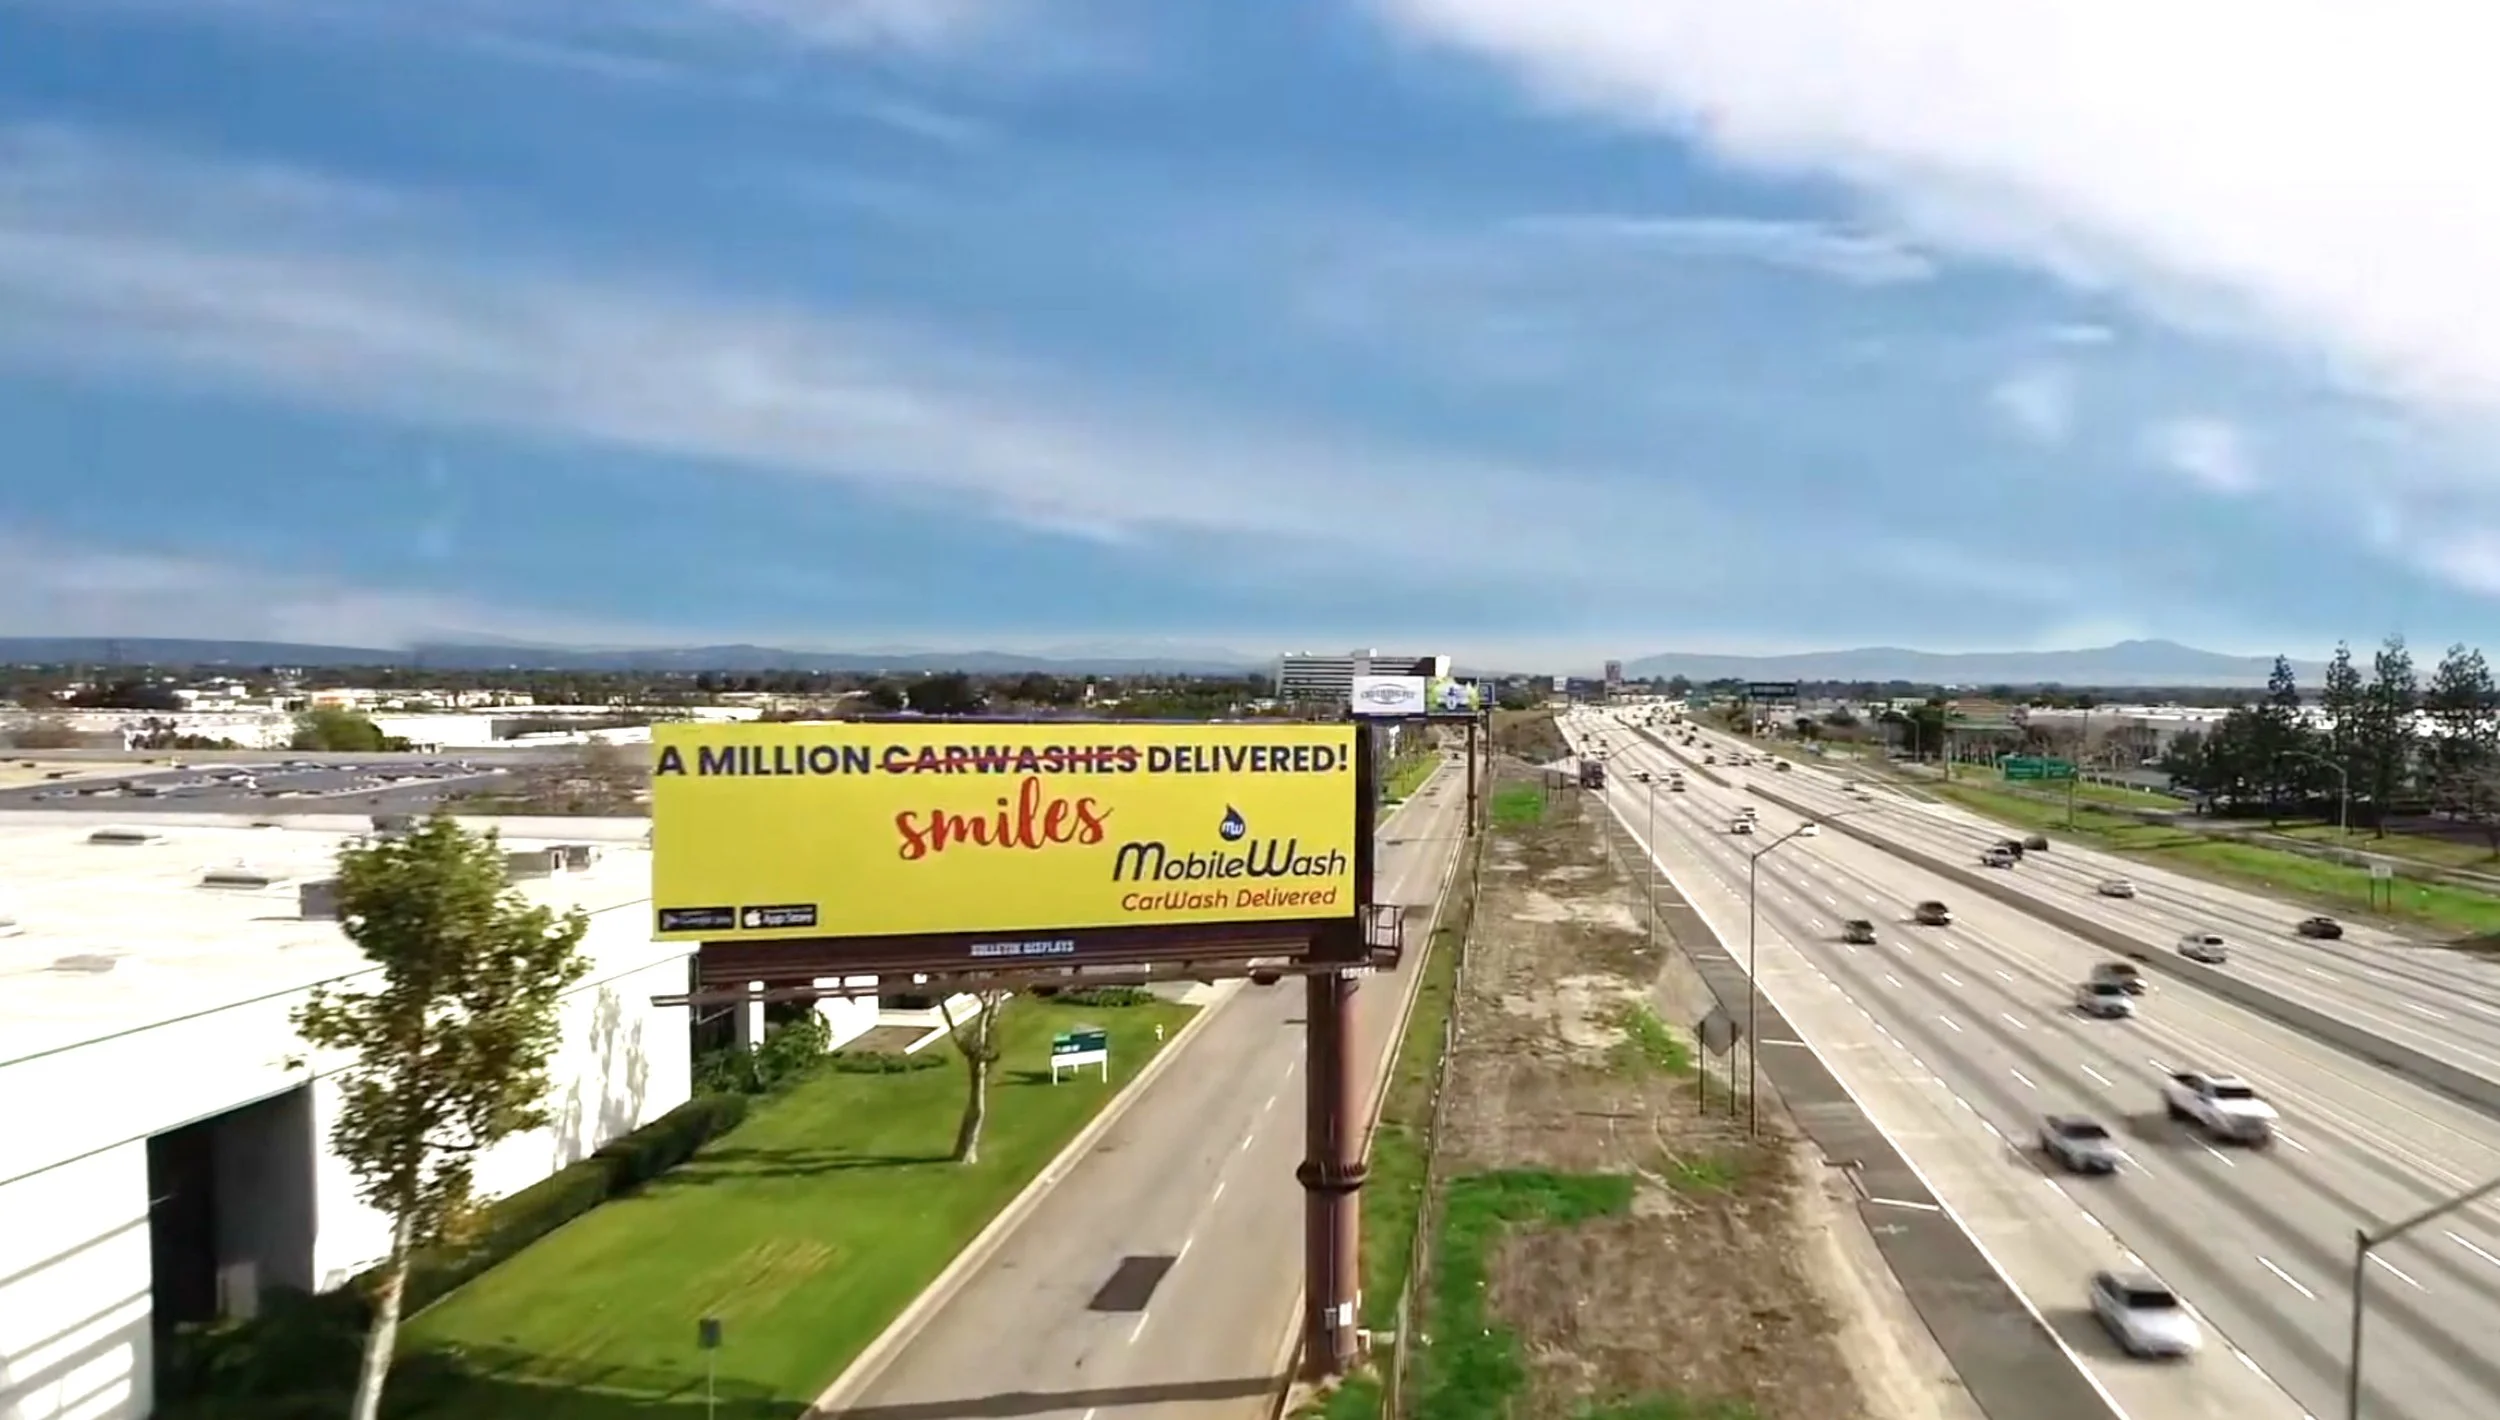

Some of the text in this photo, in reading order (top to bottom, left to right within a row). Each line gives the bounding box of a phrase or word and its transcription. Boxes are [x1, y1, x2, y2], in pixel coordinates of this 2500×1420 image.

[656, 743, 1348, 776] A MILLION CARWASHES DELIVERED!
[895, 775, 1115, 861] smiles
[1112, 838, 1347, 882] MobileWash
[1121, 886, 1337, 912] CarWash Delivered
